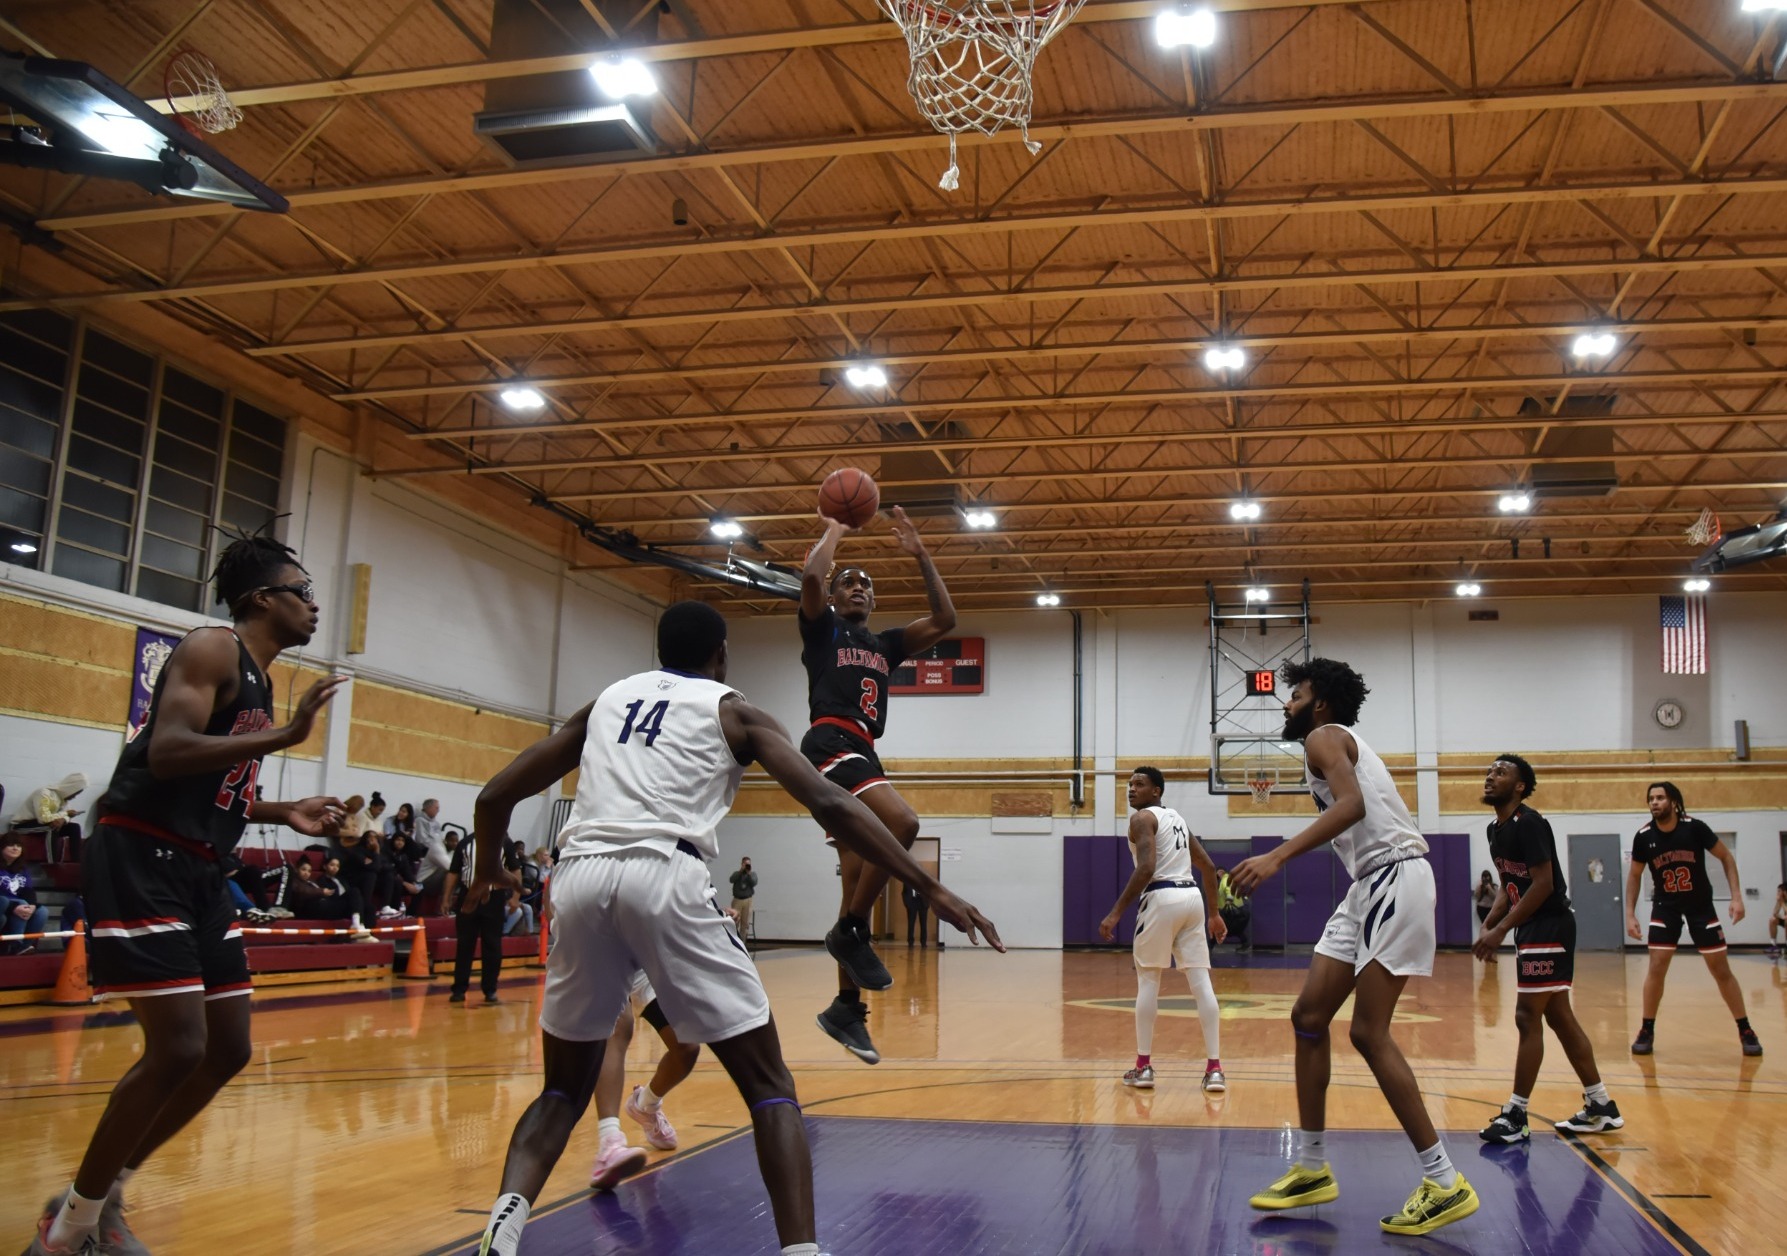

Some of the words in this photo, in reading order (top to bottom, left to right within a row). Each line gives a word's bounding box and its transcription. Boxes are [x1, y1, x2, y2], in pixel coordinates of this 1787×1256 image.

[860, 677, 878, 721] 2
[1255, 672, 1273, 691] 18
[617, 699, 670, 747] 14
[214, 759, 261, 820] 24
[1662, 866, 1693, 893] 22
[1521, 960, 1555, 976] BCCC
